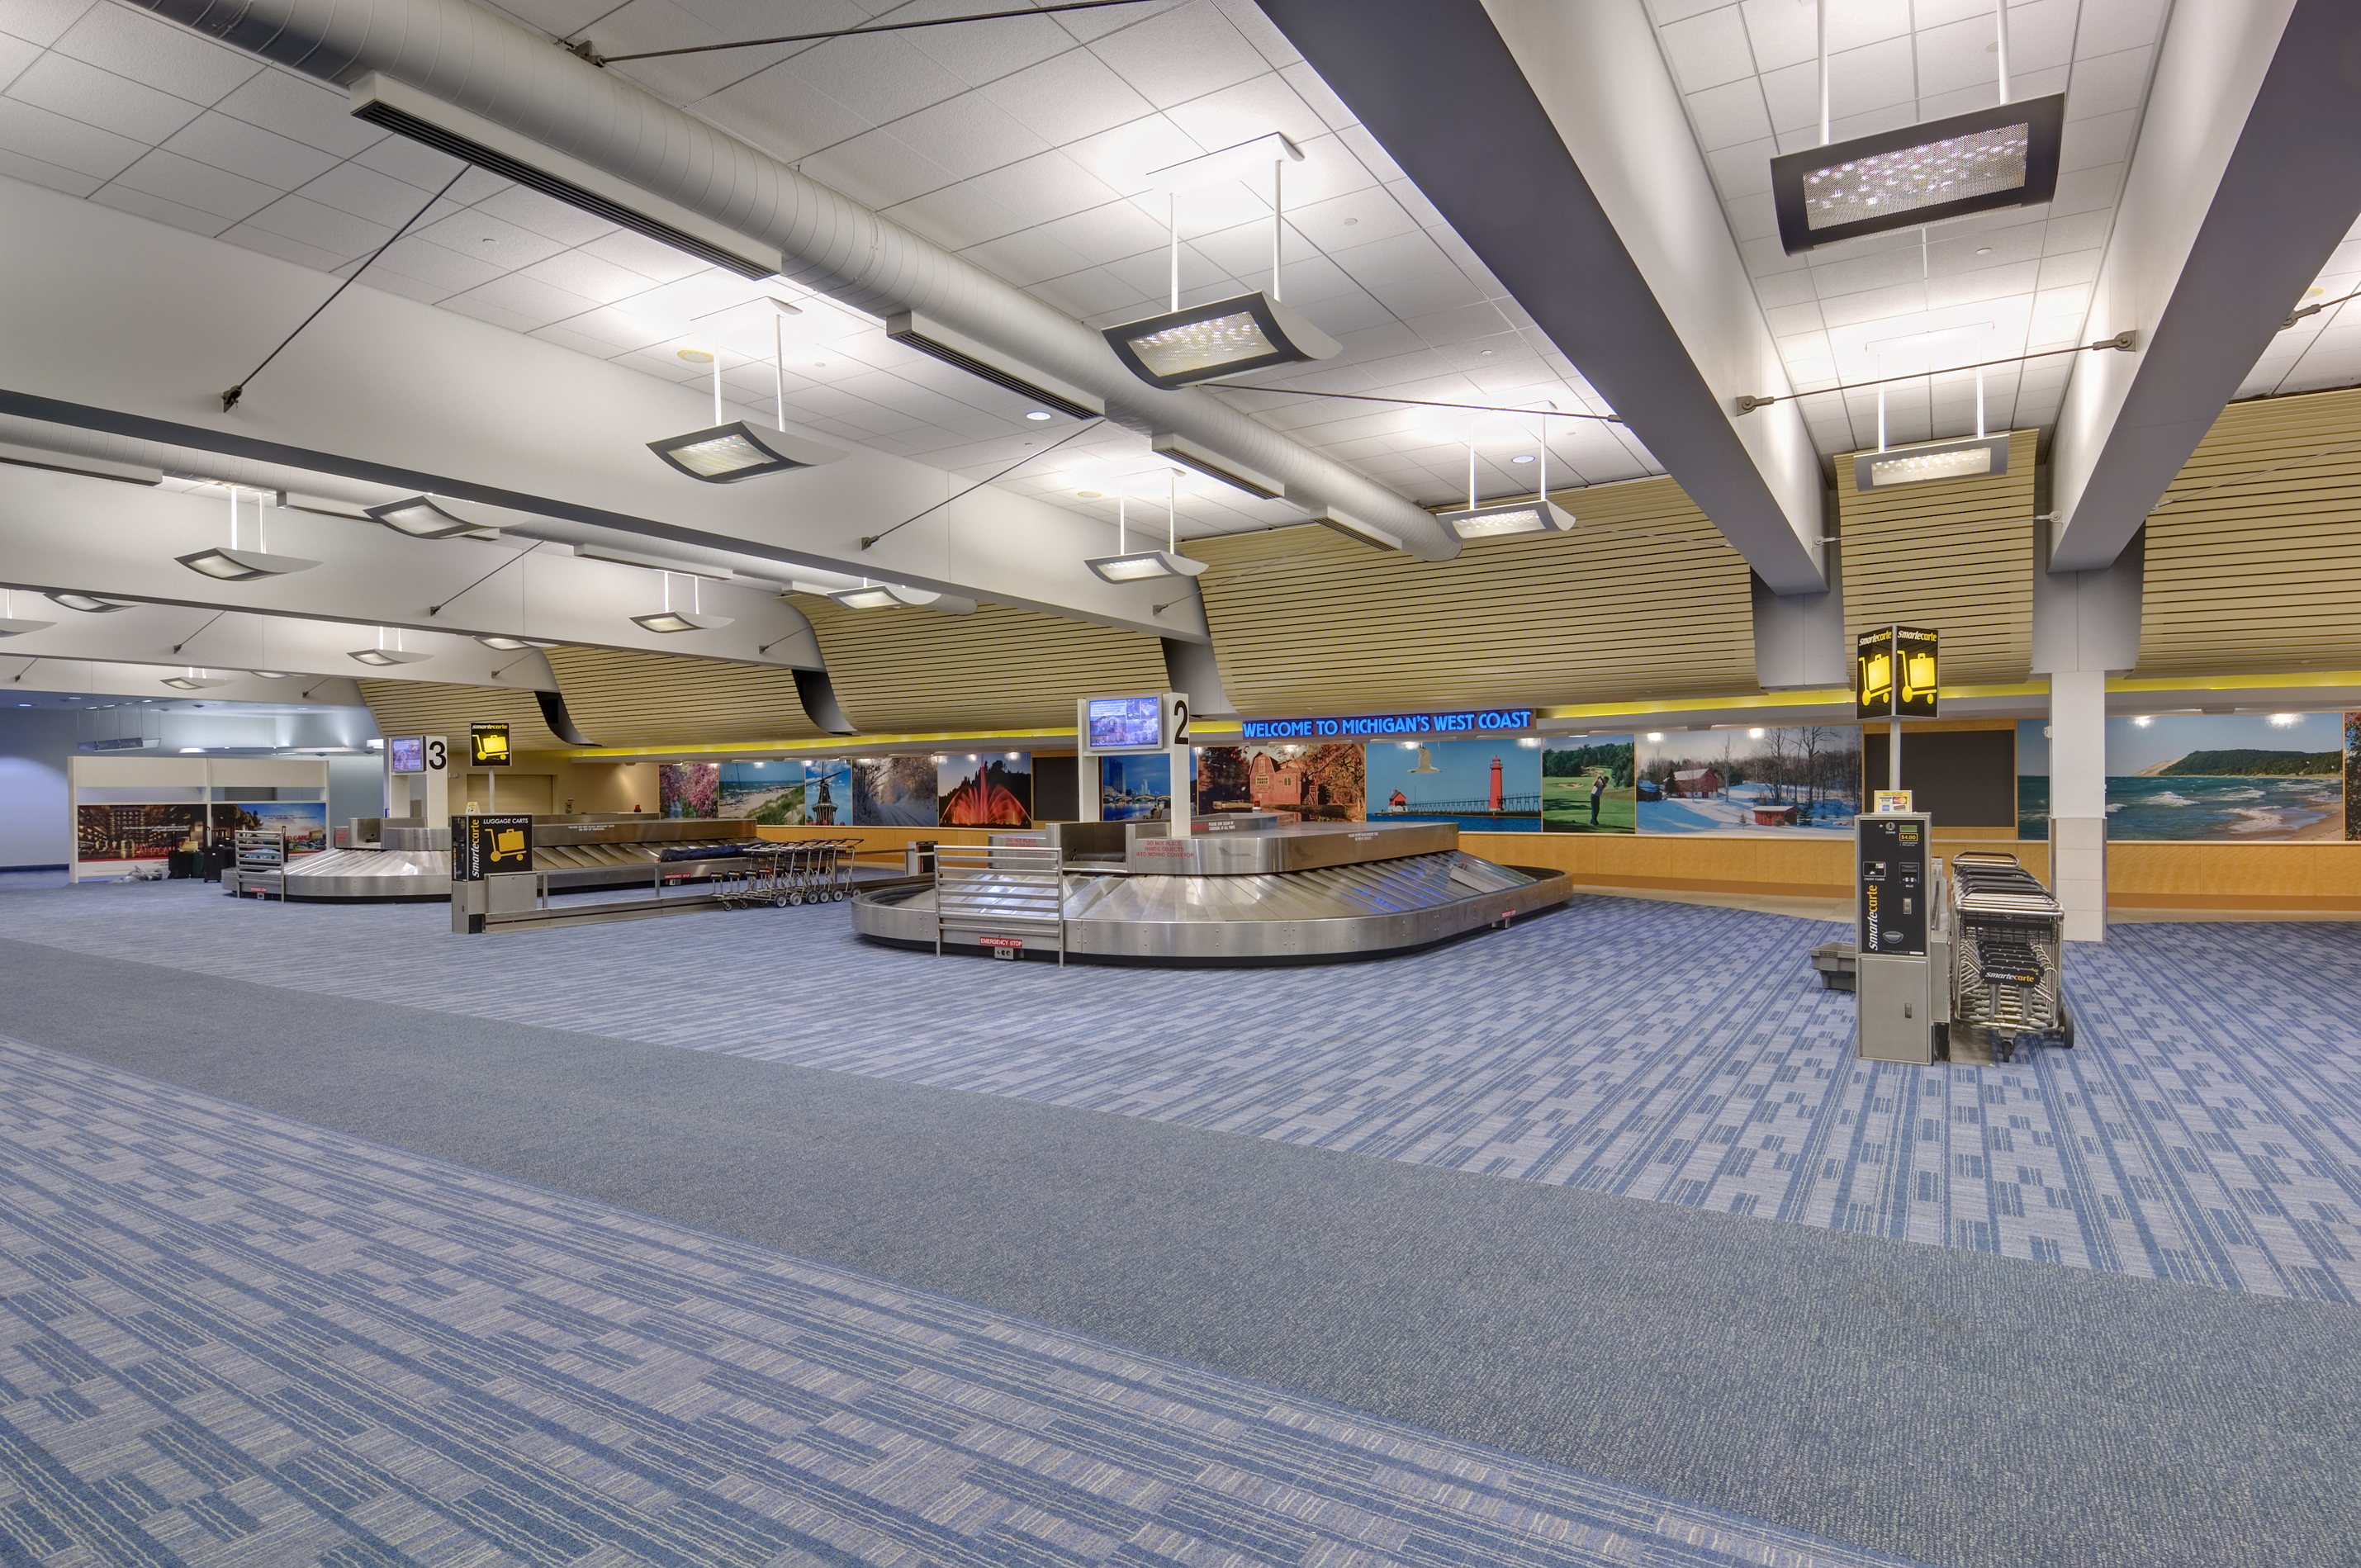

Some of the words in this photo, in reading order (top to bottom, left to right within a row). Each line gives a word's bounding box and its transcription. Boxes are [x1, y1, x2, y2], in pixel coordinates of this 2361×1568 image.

[1898, 630, 1937, 642] smartecarte
[1174, 700, 1188, 745] 2
[1243, 721, 1312, 737] WELCOME
[1316, 720, 1338, 736] TO
[1434, 714, 1474, 731] WEST
[1478, 711, 1530, 728] COAST
[429, 741, 446, 770] 3
[471, 819, 479, 878] smartecarte
[1867, 885, 1878, 950] smartecarte
[1985, 972, 2034, 982] smartecarte
